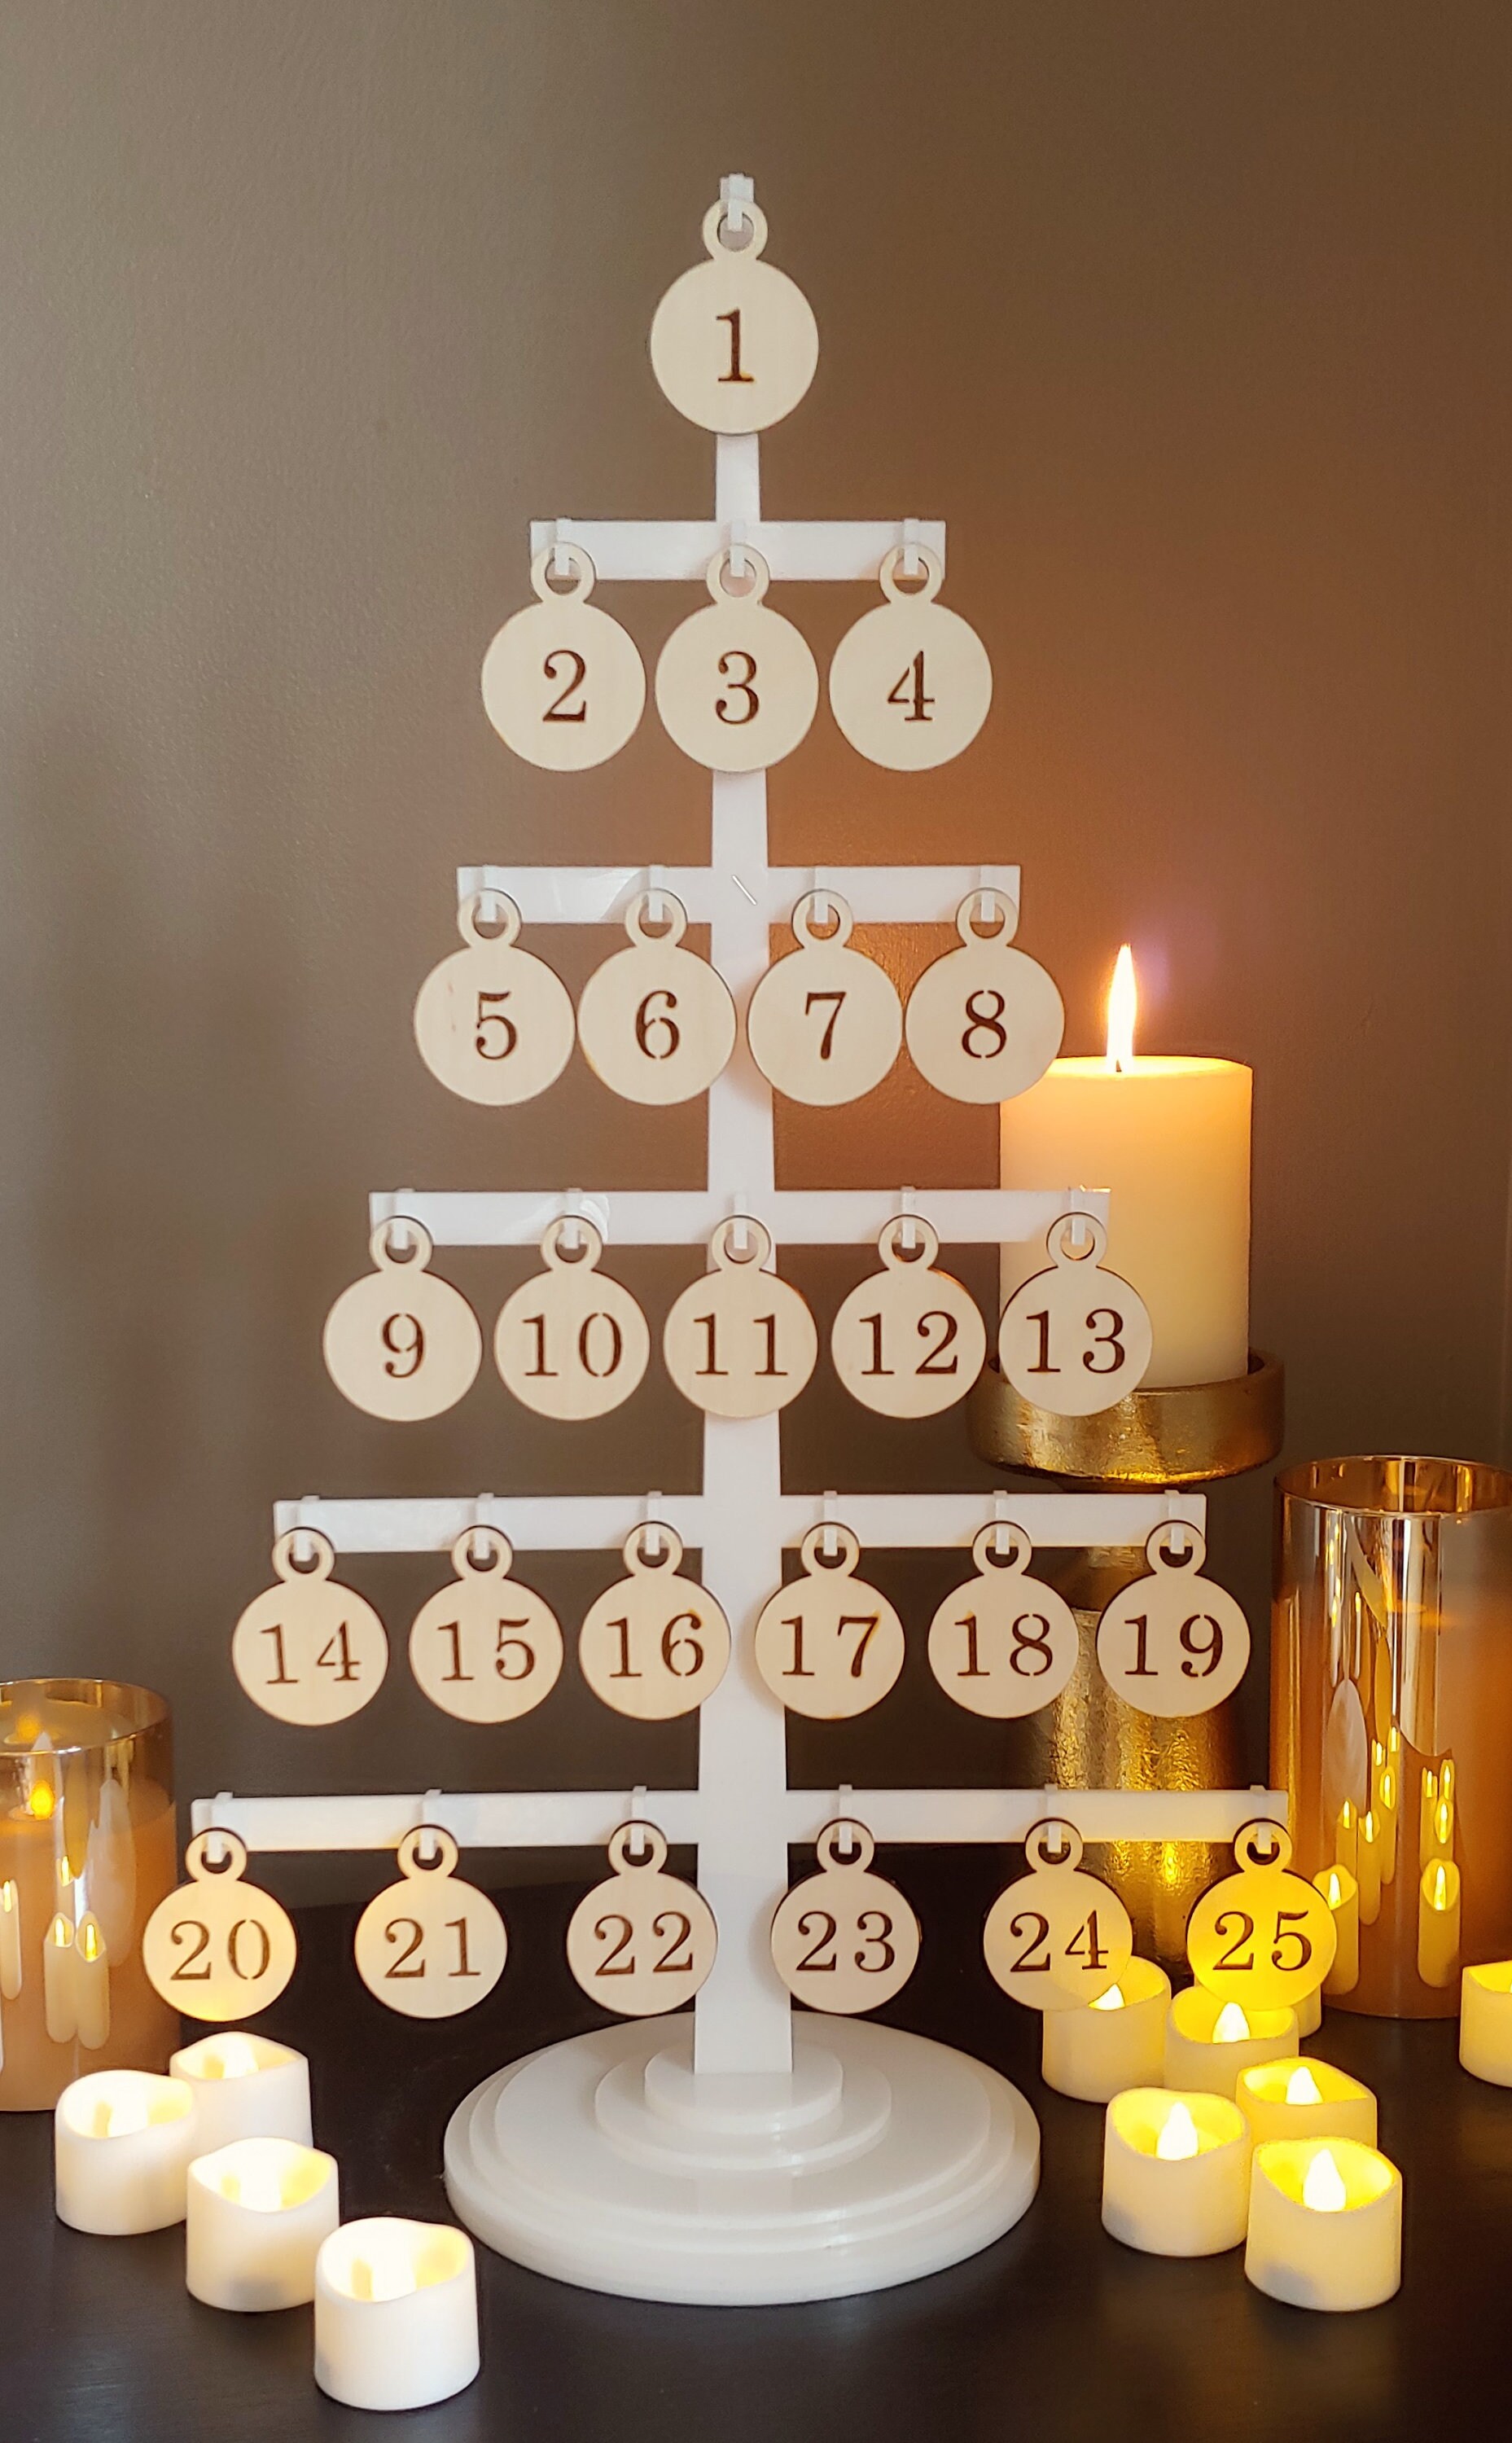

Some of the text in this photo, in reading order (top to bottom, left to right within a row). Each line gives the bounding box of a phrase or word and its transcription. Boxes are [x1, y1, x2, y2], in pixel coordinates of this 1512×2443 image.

[716, 308, 755, 384] 1
[541, 649, 587, 723] 2
[715, 651, 760, 726] 3
[887, 650, 936, 722] 4
[475, 990, 518, 1061] 5
[635, 989, 681, 1060] 6
[804, 990, 847, 1060] 7
[961, 989, 1007, 1059] 8
[381, 1313, 425, 1379] 9
[522, 1312, 623, 1378] 10
[693, 1313, 789, 1376] 11
[859, 1310, 958, 1375] 12
[1025, 1308, 1126, 1375] 13
[261, 1621, 361, 1685] 14
[437, 1617, 536, 1682] 15
[606, 1612, 704, 1678] 16
[780, 1615, 879, 1678] 17
[953, 1613, 1054, 1678] 18
[1124, 1613, 1224, 1678] 19
[170, 1919, 270, 1981] 20
[384, 1917, 481, 1979] 21
[594, 1910, 694, 1976] 22
[795, 1910, 896, 1973] 23
[1009, 1909, 1109, 1973] 24
[1212, 1910, 1313, 1972] 25
